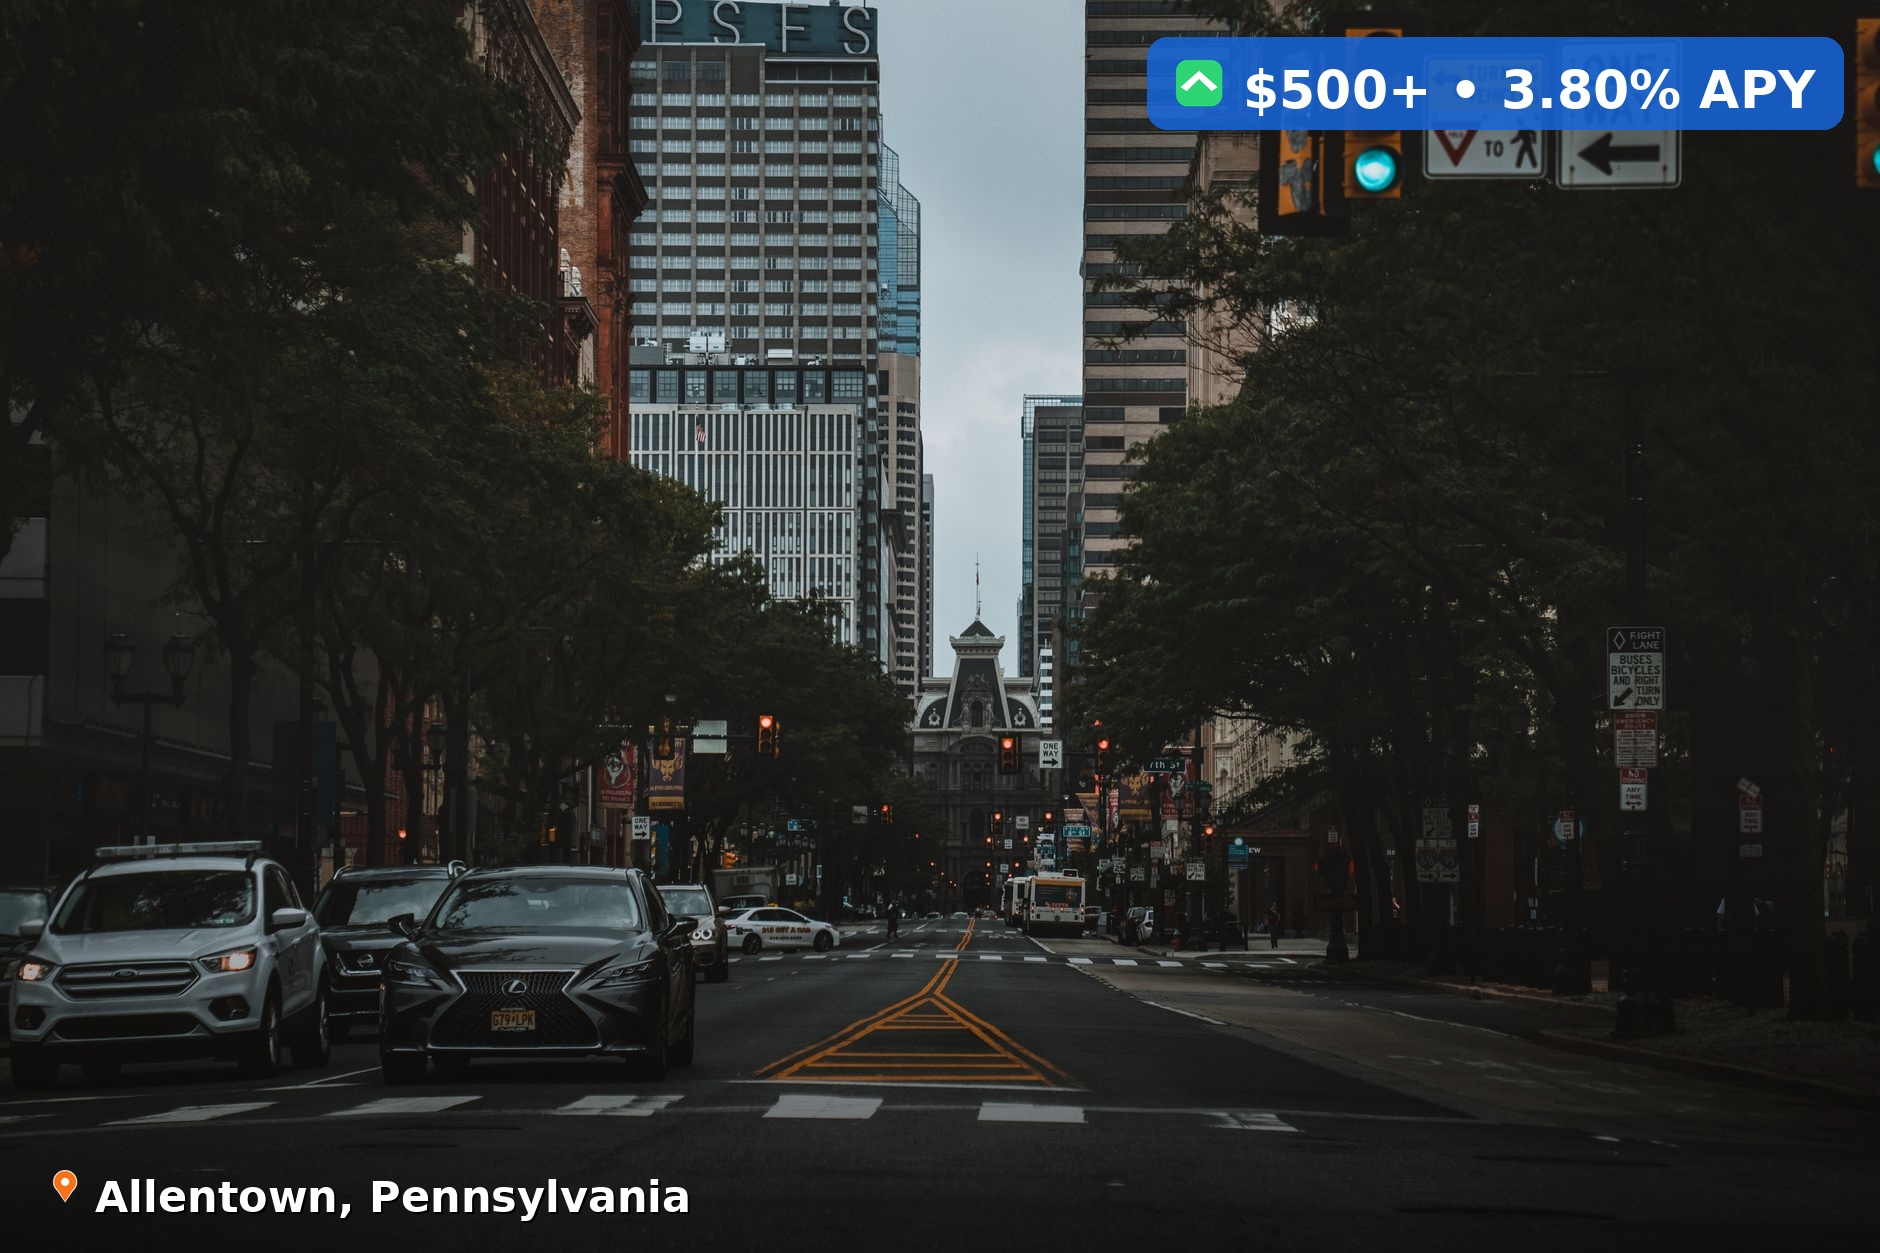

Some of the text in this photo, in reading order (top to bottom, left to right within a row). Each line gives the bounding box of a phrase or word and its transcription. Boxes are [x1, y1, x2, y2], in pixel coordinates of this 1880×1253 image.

[650, 0, 871, 54] PSFS
[1485, 140, 1503, 157] TO
[1633, 641, 1660, 650] LANE
[1620, 655, 1652, 664] BUSES
[1611, 665, 1661, 675] BICYCLES
[1613, 676, 1659, 685] AND RIGHT
[1637, 686, 1660, 695] TURN
[1637, 696, 1660, 706] ONLY
[1043, 742, 1058, 750] ONE
[1628, 769, 1640, 778] NO
